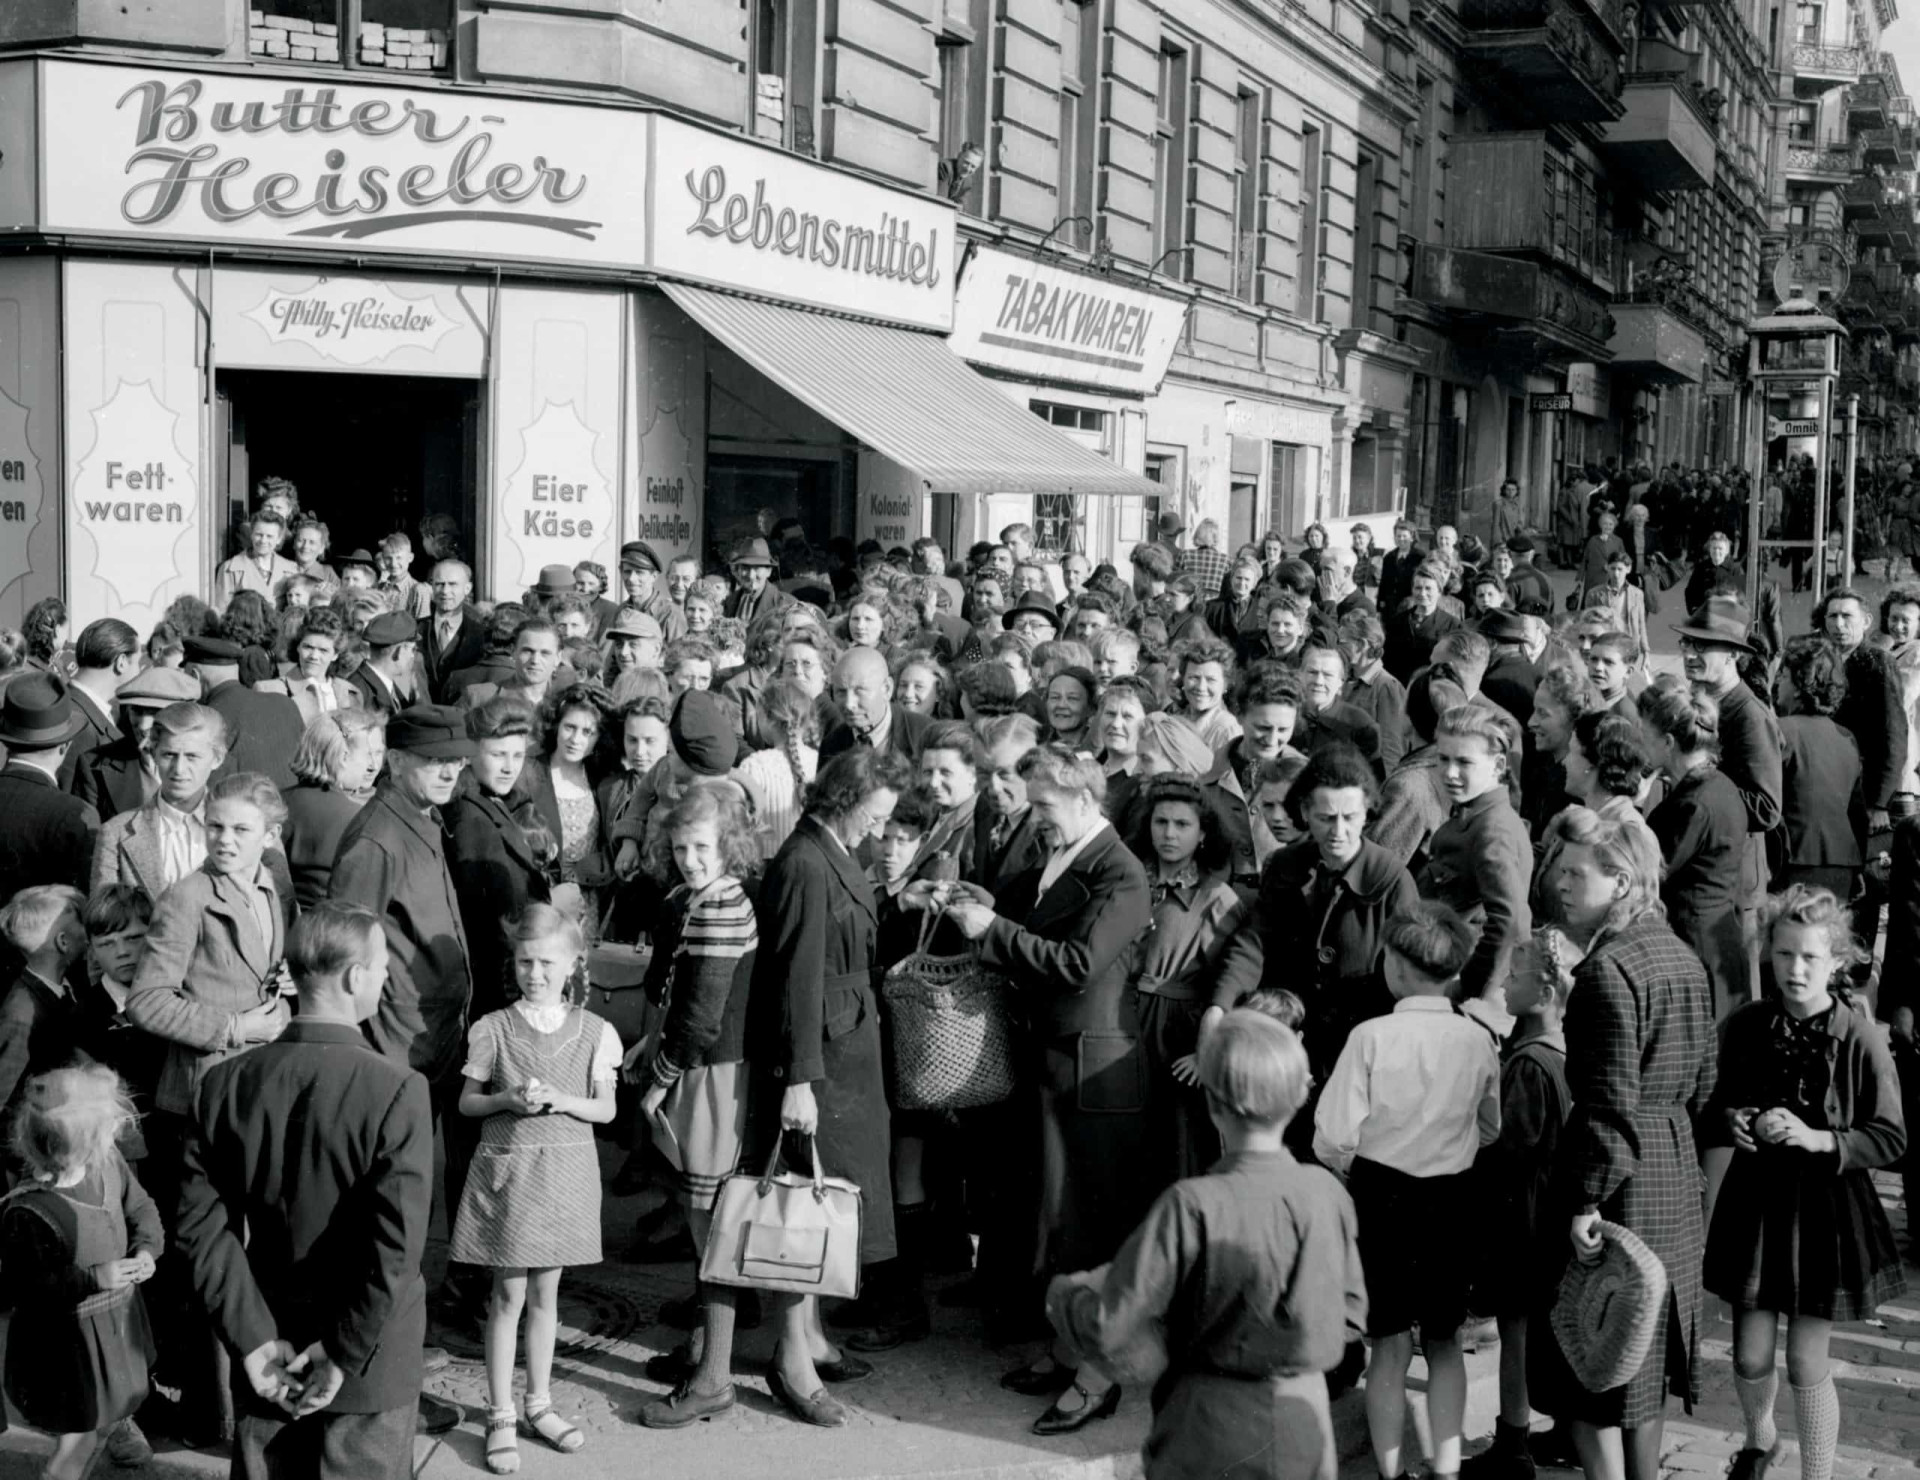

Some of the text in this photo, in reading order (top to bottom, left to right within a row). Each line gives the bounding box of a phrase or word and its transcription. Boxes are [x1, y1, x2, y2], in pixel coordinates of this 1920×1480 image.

[115, 78, 505, 147] Butter-
[120, 132, 588, 226] Heiseler
[685, 164, 940, 290] Lebensmittel
[270, 297, 436, 340] Willy Heiseler
[1785, 422, 1818, 433] Omnib
[0, 460, 25, 481] en
[532, 474, 588, 502] Eier
[0, 500, 26, 521] en
[84, 500, 183, 523] waren
[524, 509, 595, 539] Käse
[873, 525, 906, 541] waren
